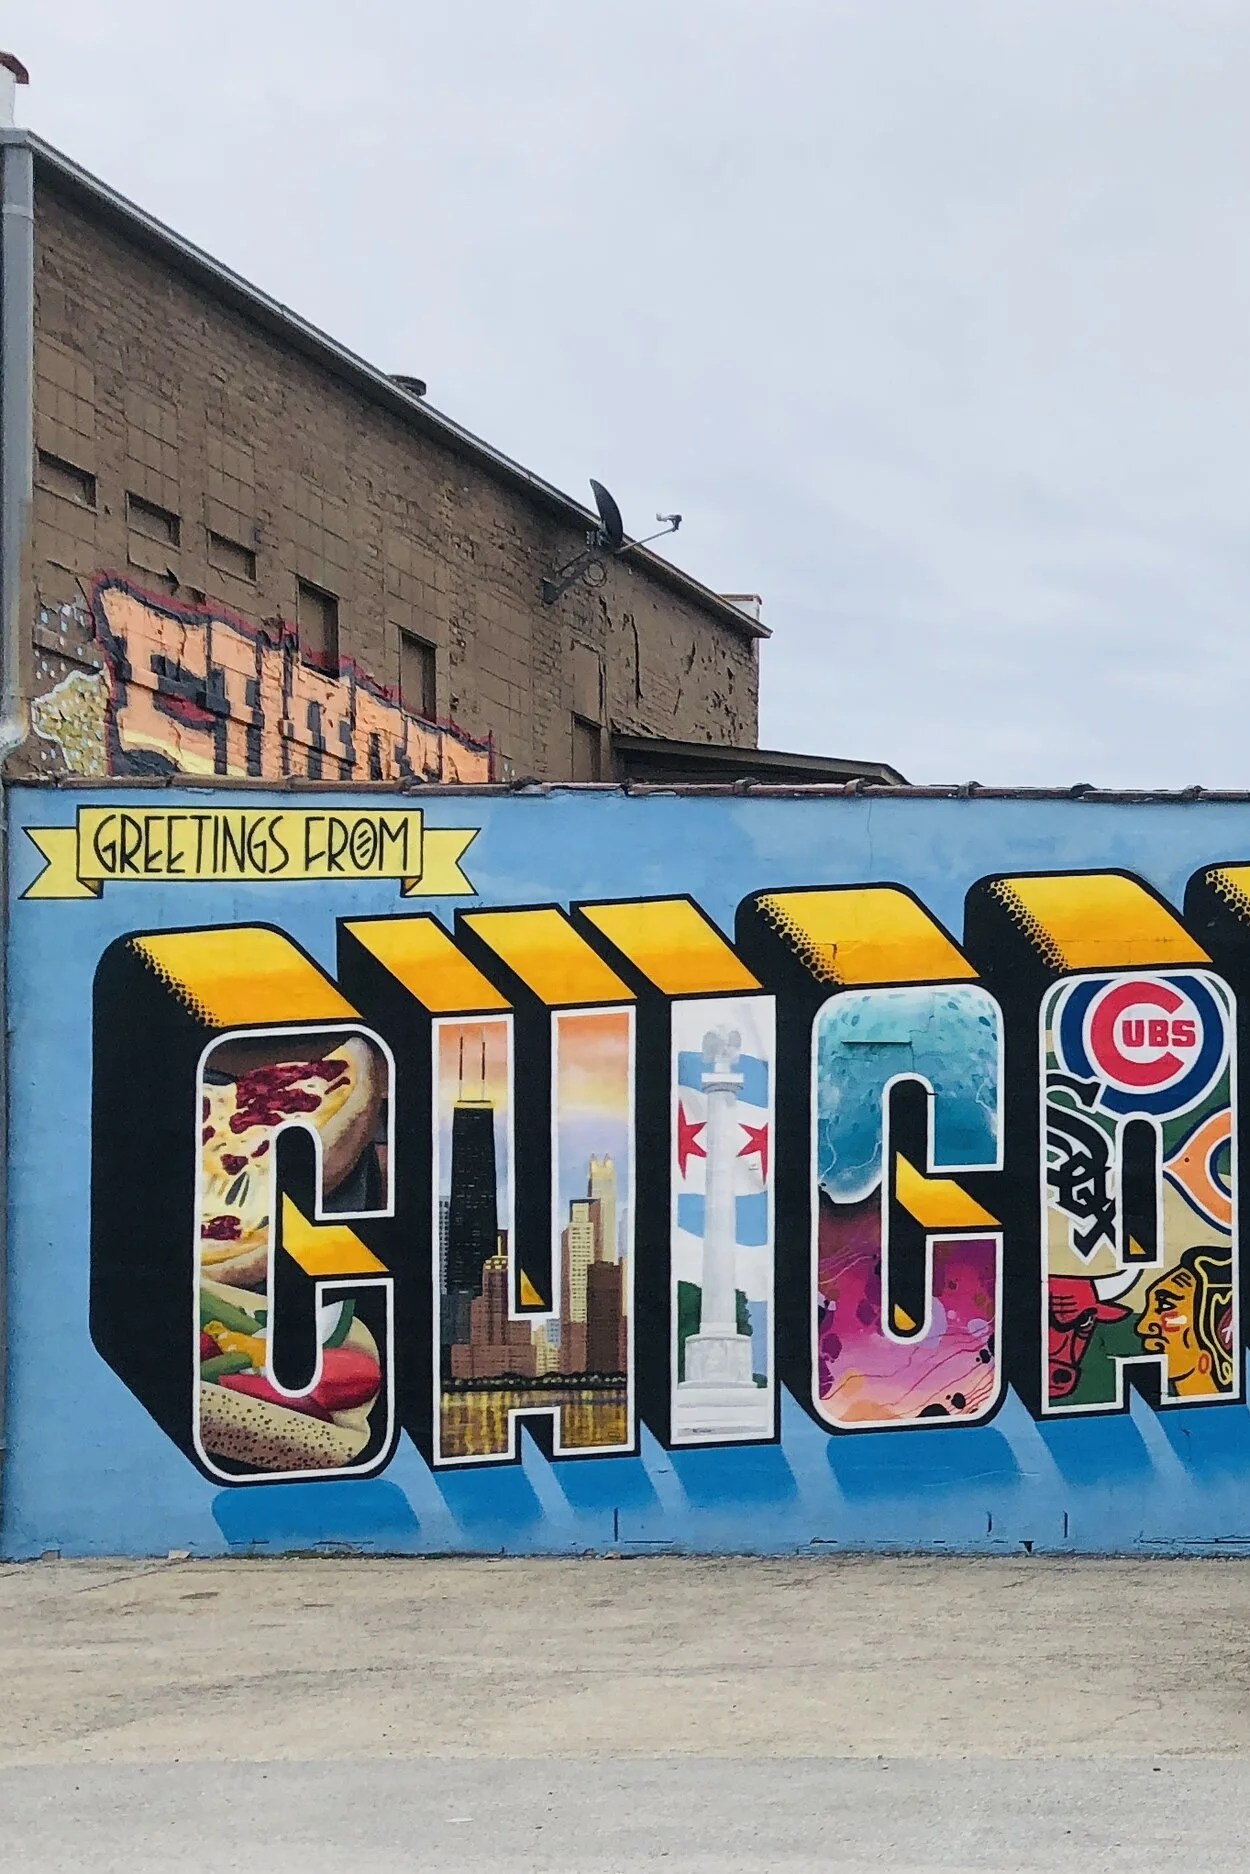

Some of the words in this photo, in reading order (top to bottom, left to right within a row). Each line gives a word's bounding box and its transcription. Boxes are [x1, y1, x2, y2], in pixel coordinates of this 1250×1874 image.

[93, 813, 290, 875] GREETINGS
[303, 815, 410, 873] FROM
[1090, 980, 1197, 1087] CUBS
